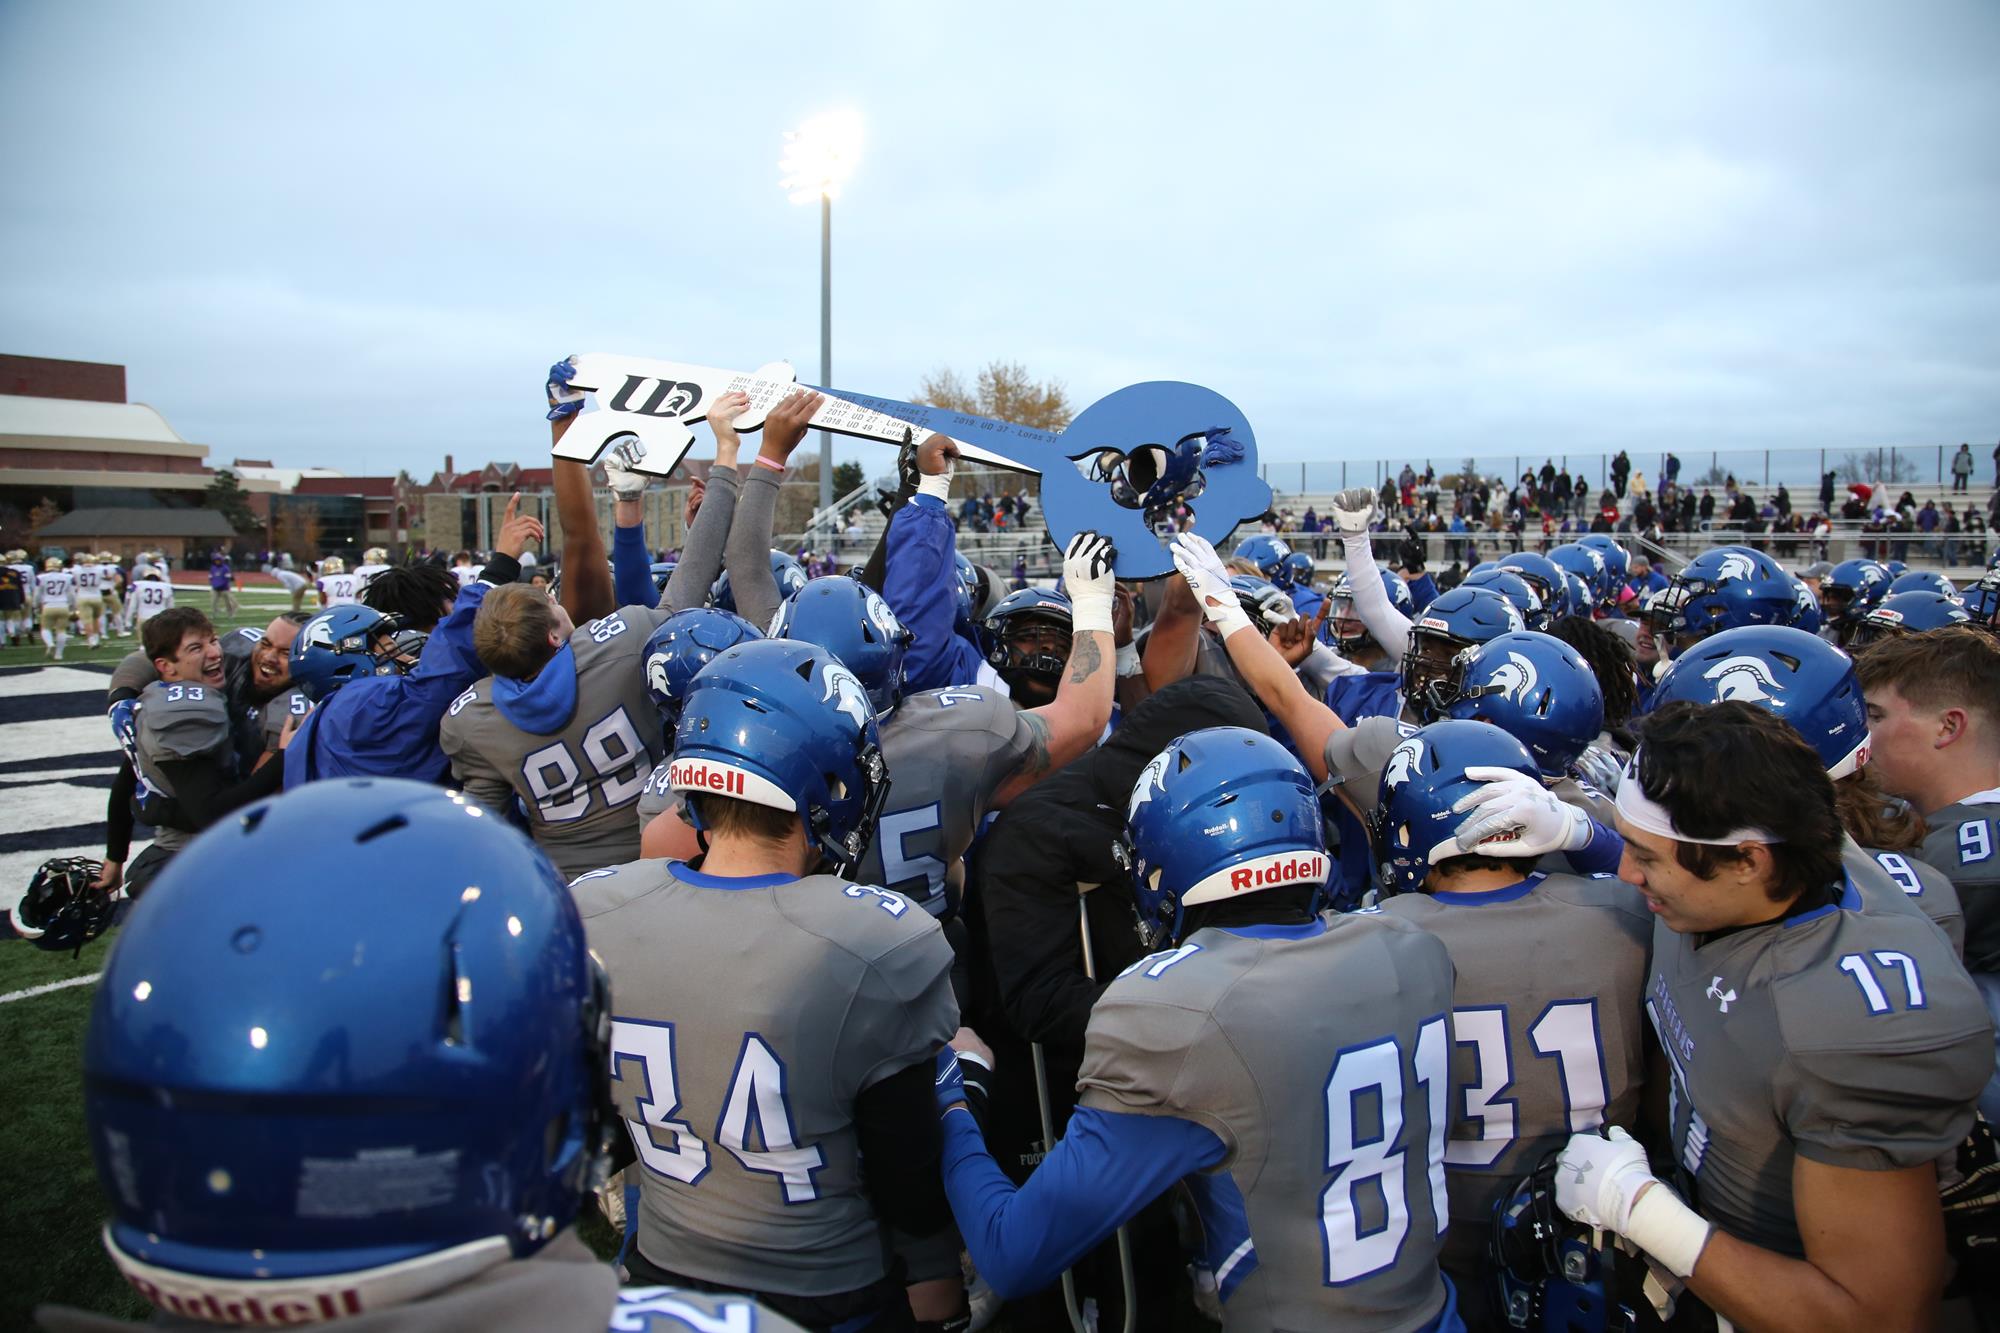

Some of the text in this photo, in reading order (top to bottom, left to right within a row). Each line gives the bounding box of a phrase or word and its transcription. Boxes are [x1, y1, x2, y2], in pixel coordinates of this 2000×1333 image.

[609, 374, 703, 418] UD
[1018, 429, 1043, 441] Loras
[46, 580, 65, 596] 27
[80, 573, 96, 587] 97
[335, 581, 353, 598] 22
[144, 588, 163, 605] 33
[167, 685, 204, 702] 33
[671, 764, 745, 795] Riddell
[1230, 857, 1322, 891] Riddell
[1836, 950, 1928, 1016] 17
[1444, 997, 1609, 1170] 31
[610, 1016, 826, 1206] 34
[1318, 1012, 1450, 1288] 81
